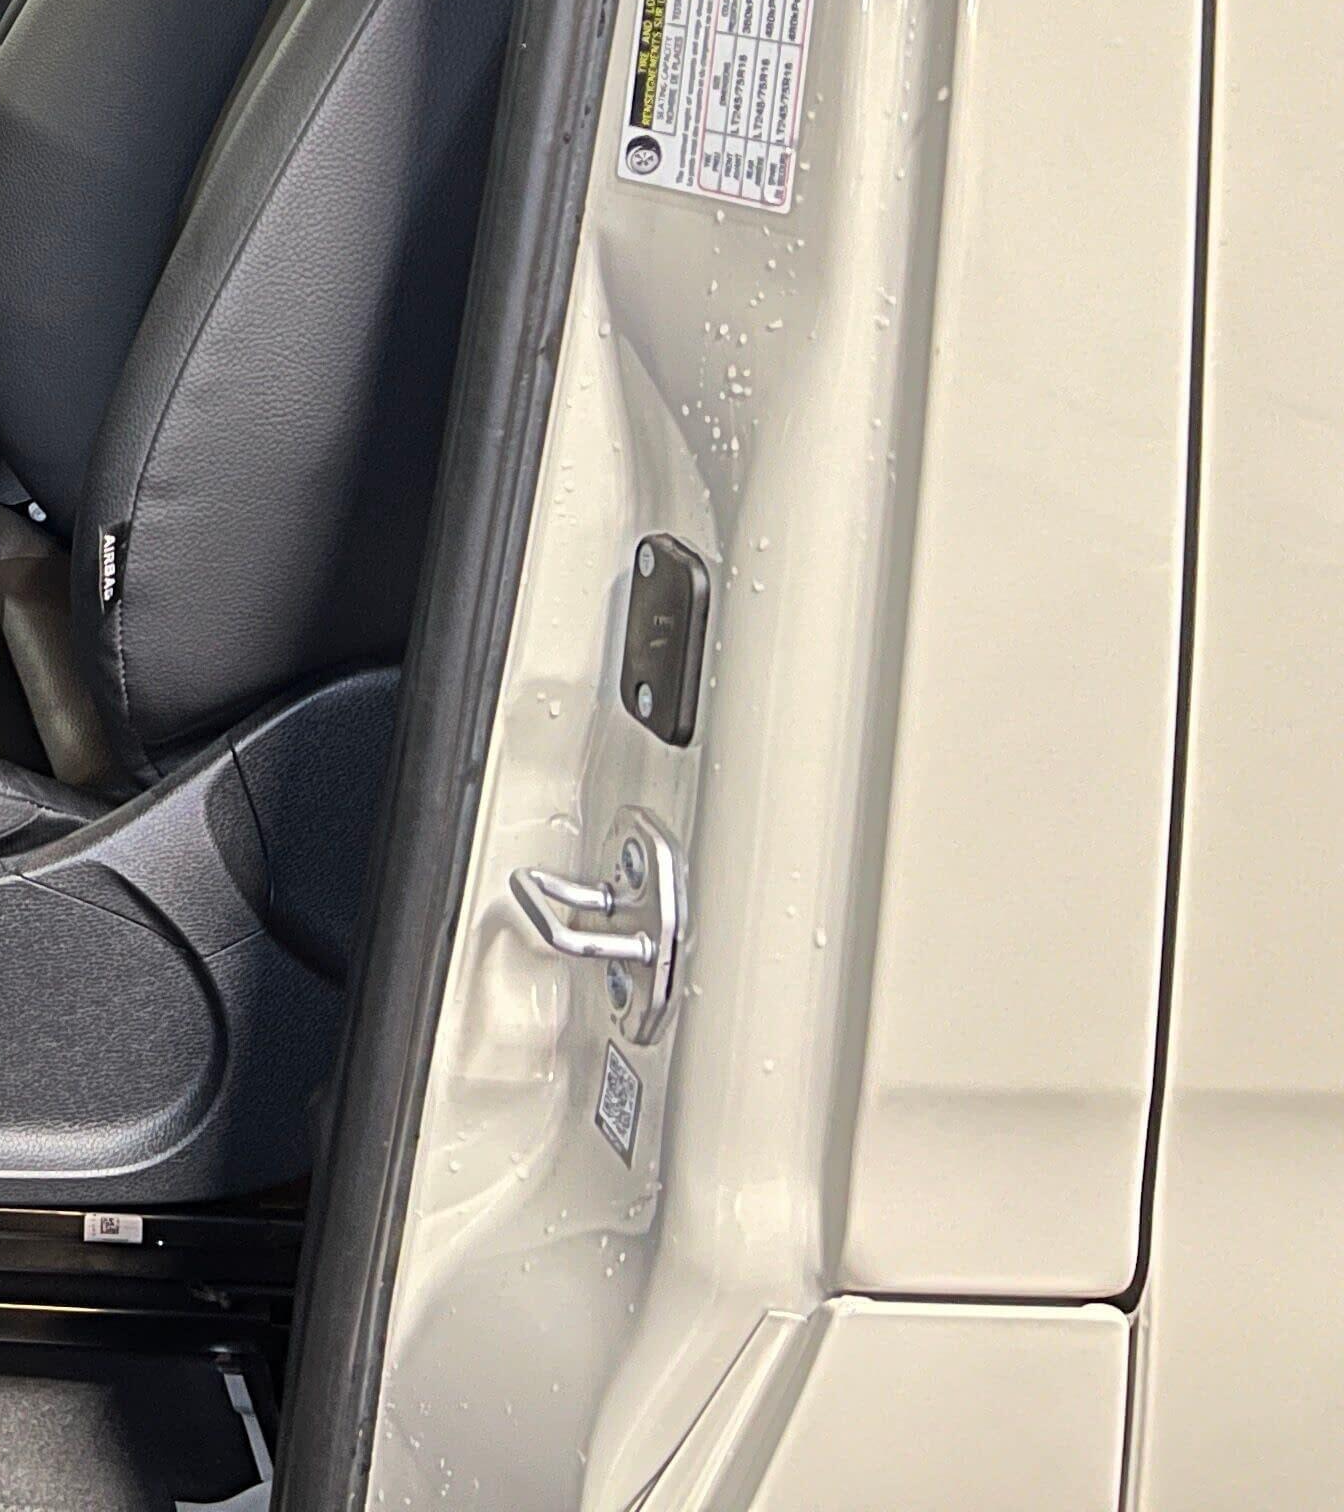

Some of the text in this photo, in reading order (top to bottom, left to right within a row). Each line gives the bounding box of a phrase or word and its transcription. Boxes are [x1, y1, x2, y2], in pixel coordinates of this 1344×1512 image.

[641, 19, 653, 44] AND
[637, 50, 649, 73] TIRE
[641, 30, 662, 126] RENSEIGNEMENTS
[653, 5, 664, 28] SUR
[103, 534, 116, 602] AIRBAG
